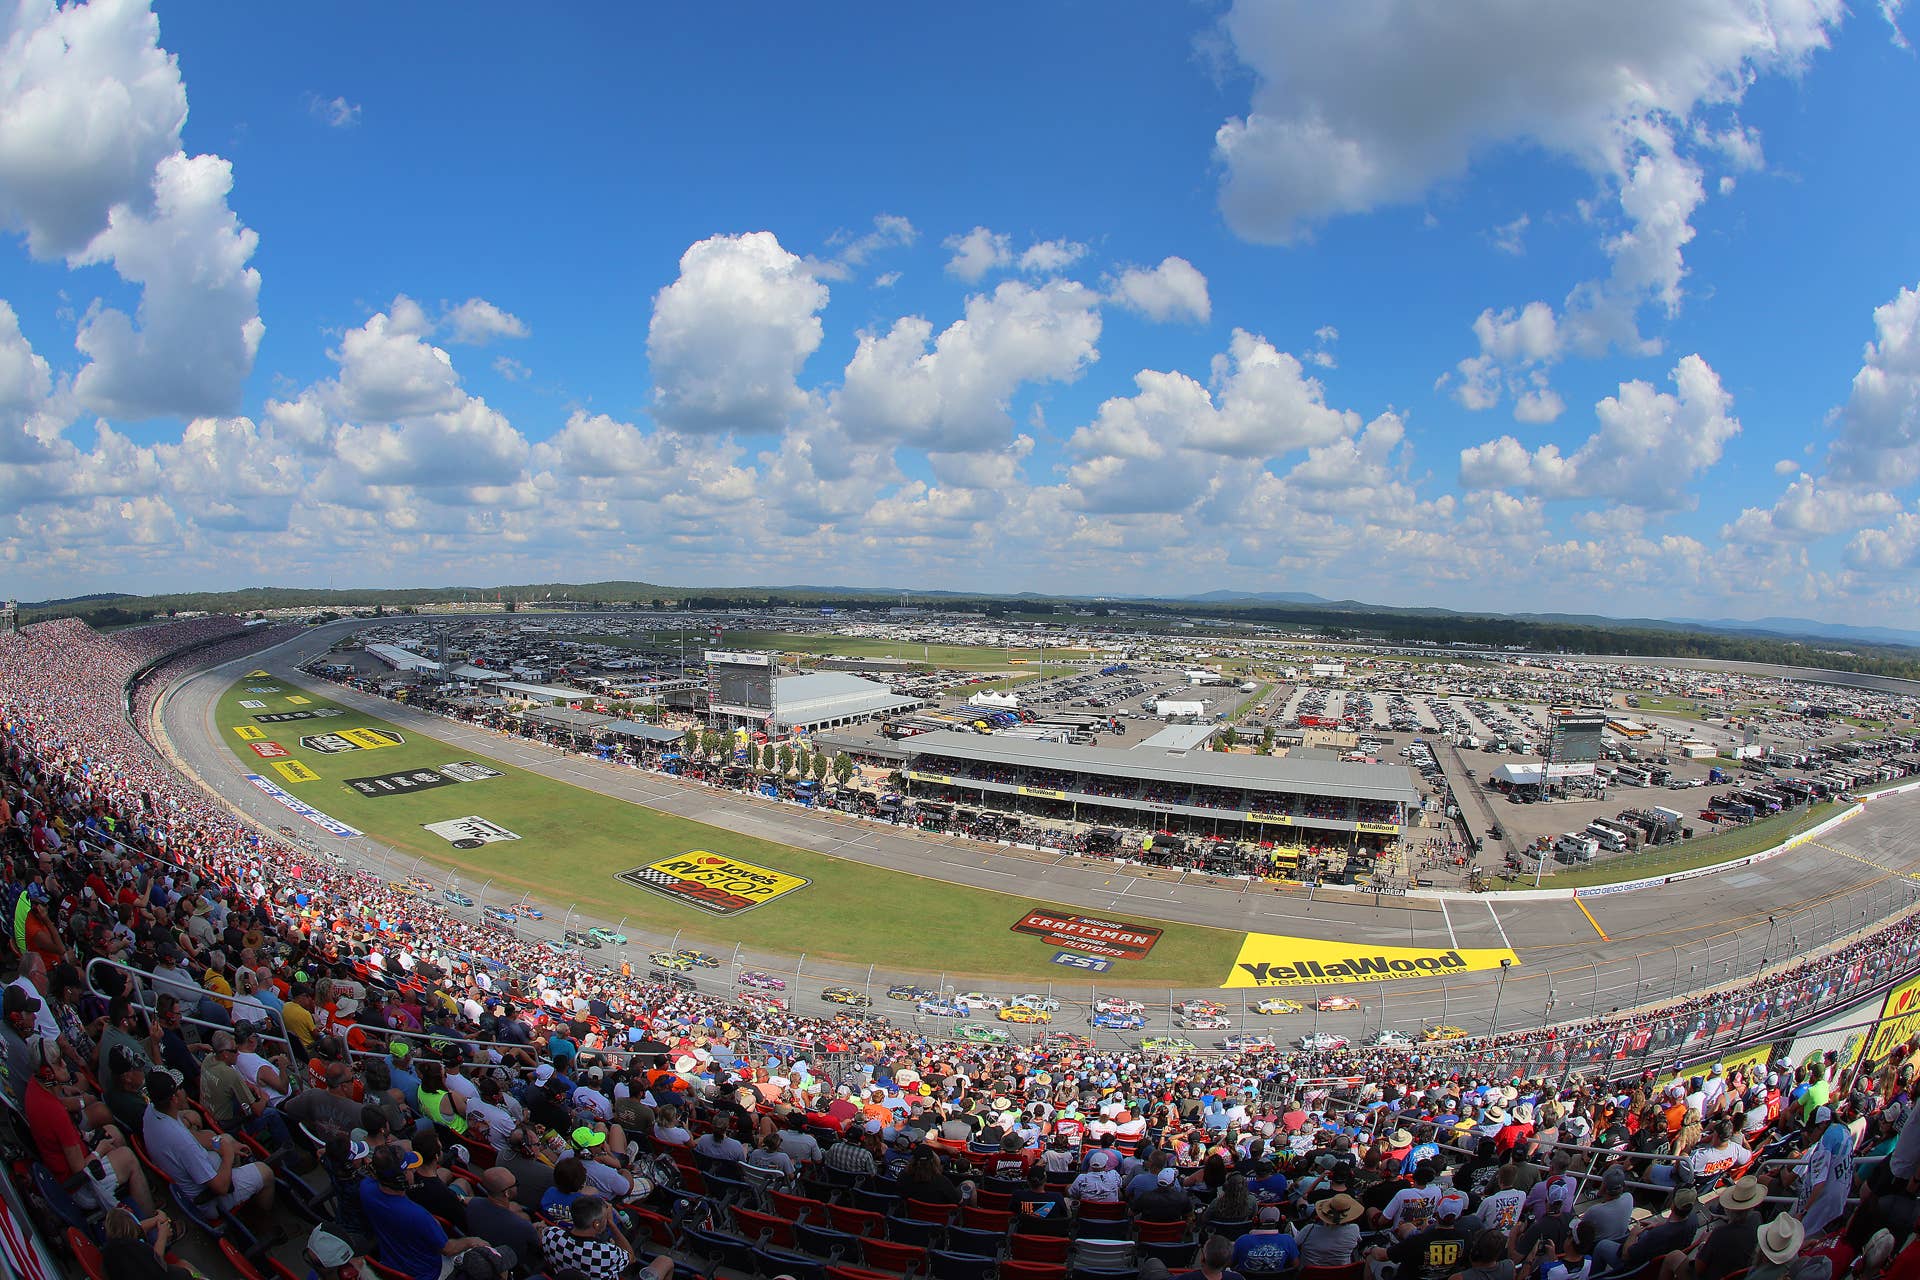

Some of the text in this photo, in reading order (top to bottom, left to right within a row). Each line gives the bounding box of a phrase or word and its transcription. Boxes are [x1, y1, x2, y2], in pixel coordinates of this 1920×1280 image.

[1360, 822, 1394, 830] YellaWood
[666, 880, 758, 909] 225
[1577, 878, 1664, 896] GEICO GEICO GEICO GEICO
[1028, 917, 1148, 944] CRAFTSMAN
[1080, 918, 1122, 929] NASCAR
[1064, 940, 1125, 956] PLAYOFFS
[1056, 954, 1107, 971] FS1
[1239, 951, 1467, 980] YellaWood
[1256, 966, 1467, 986] Pressure Treated Pine
